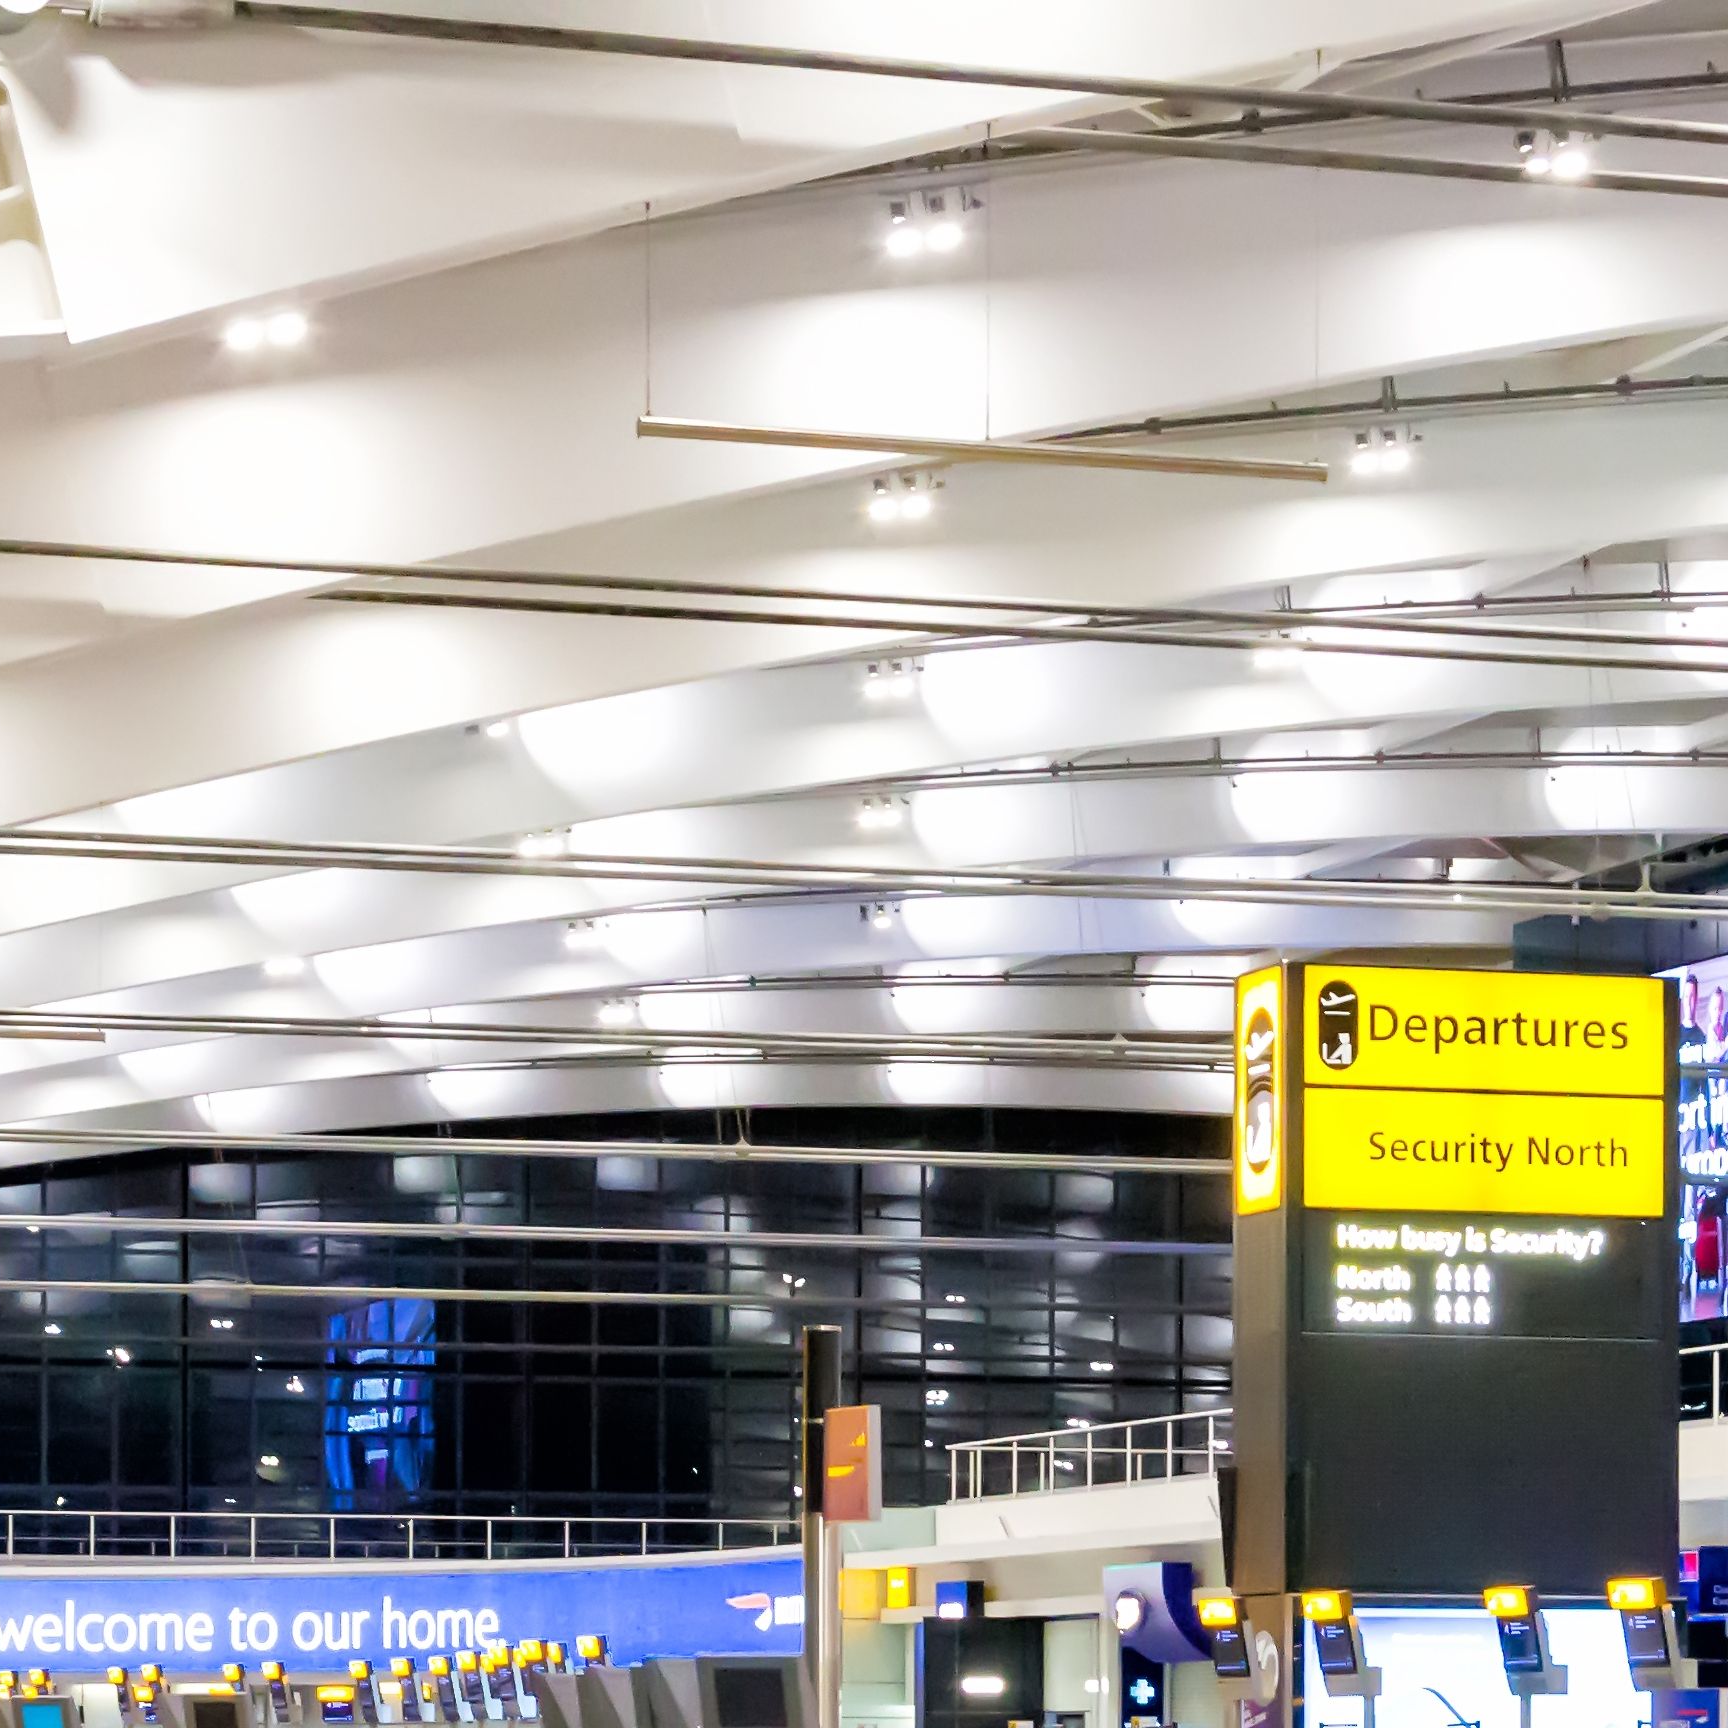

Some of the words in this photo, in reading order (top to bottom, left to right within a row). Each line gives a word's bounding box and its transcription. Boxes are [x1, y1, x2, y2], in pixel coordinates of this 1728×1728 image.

[1369, 1004, 1629, 1054] Departures
[1369, 1132, 1514, 1174] Security
[1528, 1136, 1628, 1168] North
[1336, 1223, 1398, 1250] How
[1401, 1224, 1462, 1258] busy
[1465, 1226, 1487, 1253] is
[1490, 1227, 1606, 1261] Security?
[1335, 1264, 1412, 1291] North
[1335, 1296, 1413, 1324] South
[228, 1607, 279, 1652] to
[291, 1610, 371, 1652] our
